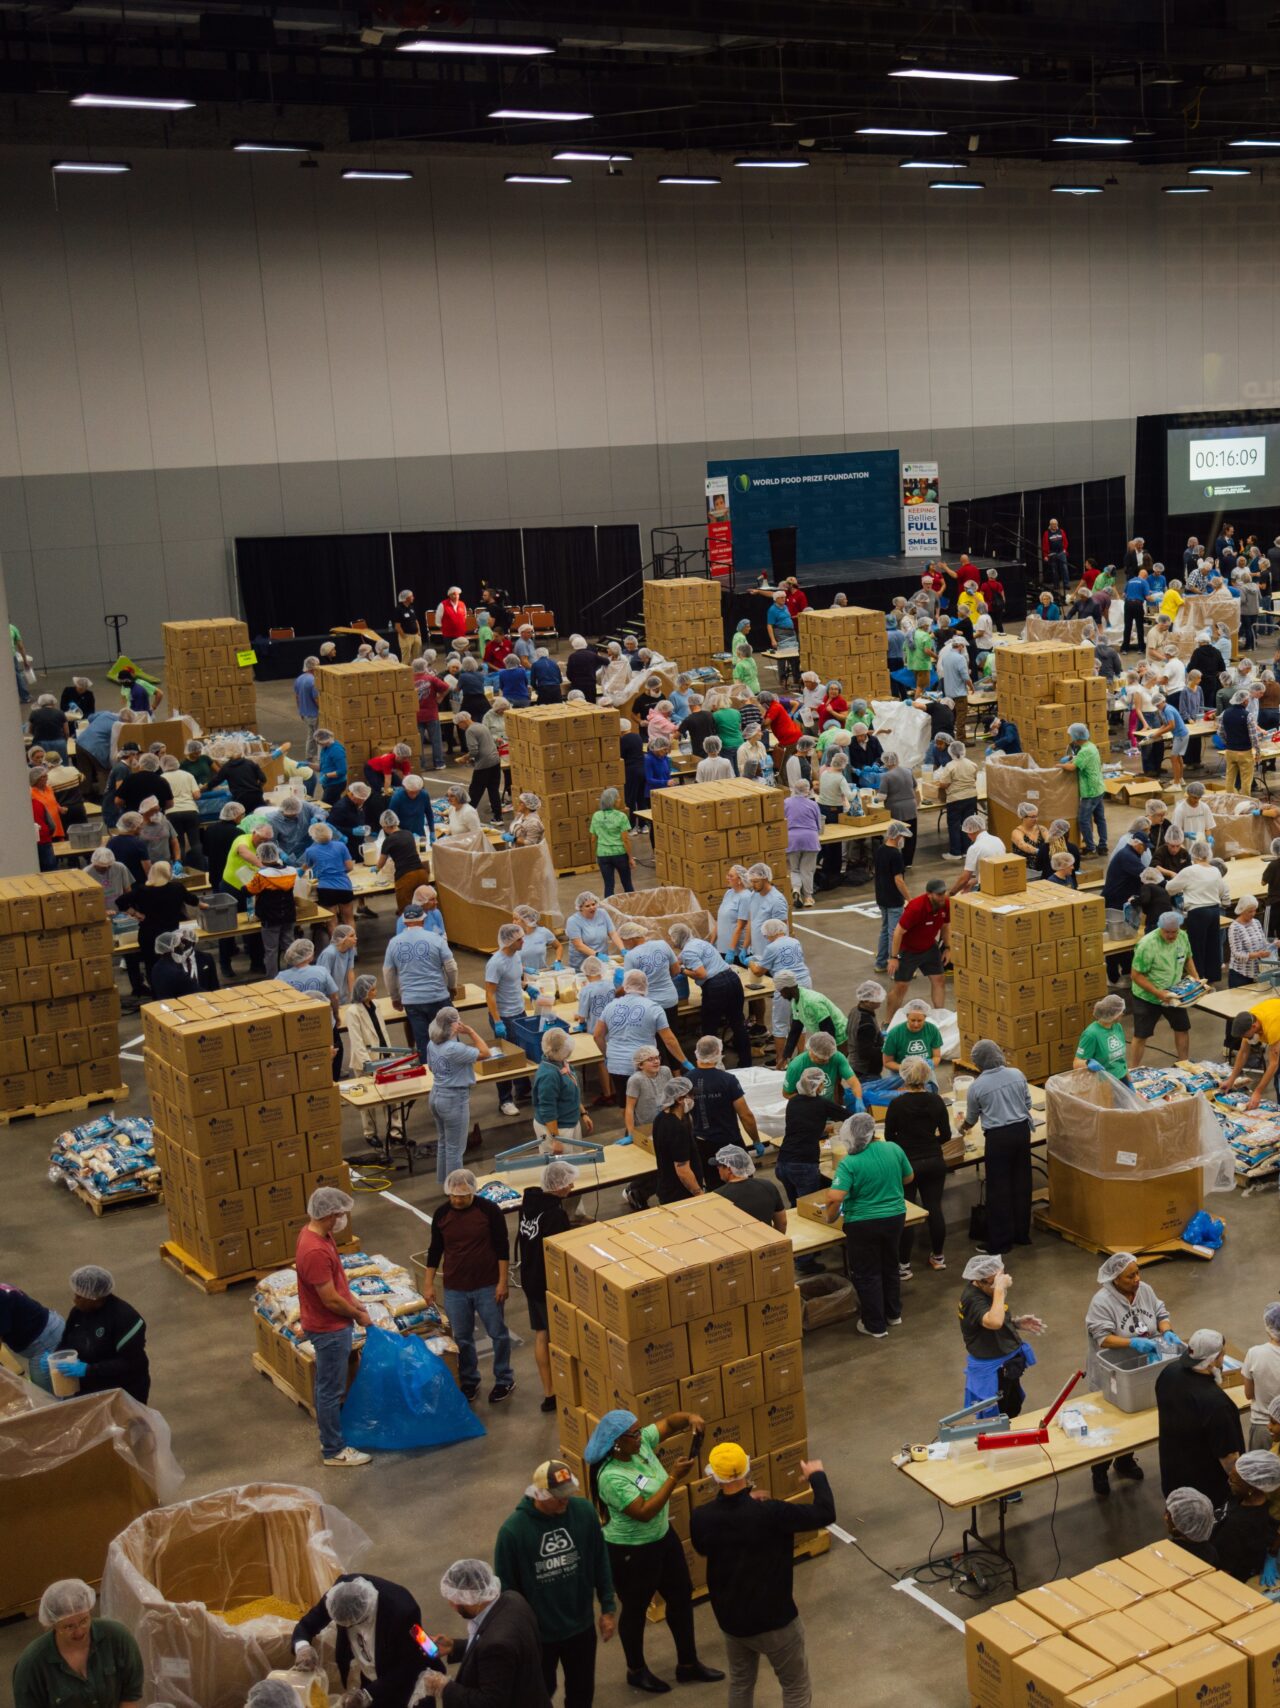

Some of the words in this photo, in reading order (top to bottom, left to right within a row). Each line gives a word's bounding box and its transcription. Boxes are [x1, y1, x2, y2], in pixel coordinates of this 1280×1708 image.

[1196, 448, 1258, 468] 00:16:09
[753, 478, 780, 486] WORLD
[824, 471, 870, 481] FOUNDATION
[908, 514, 937, 522] Bellies
[908, 522, 937, 531] FULL
[1209, 1681, 1232, 1694] Meals
